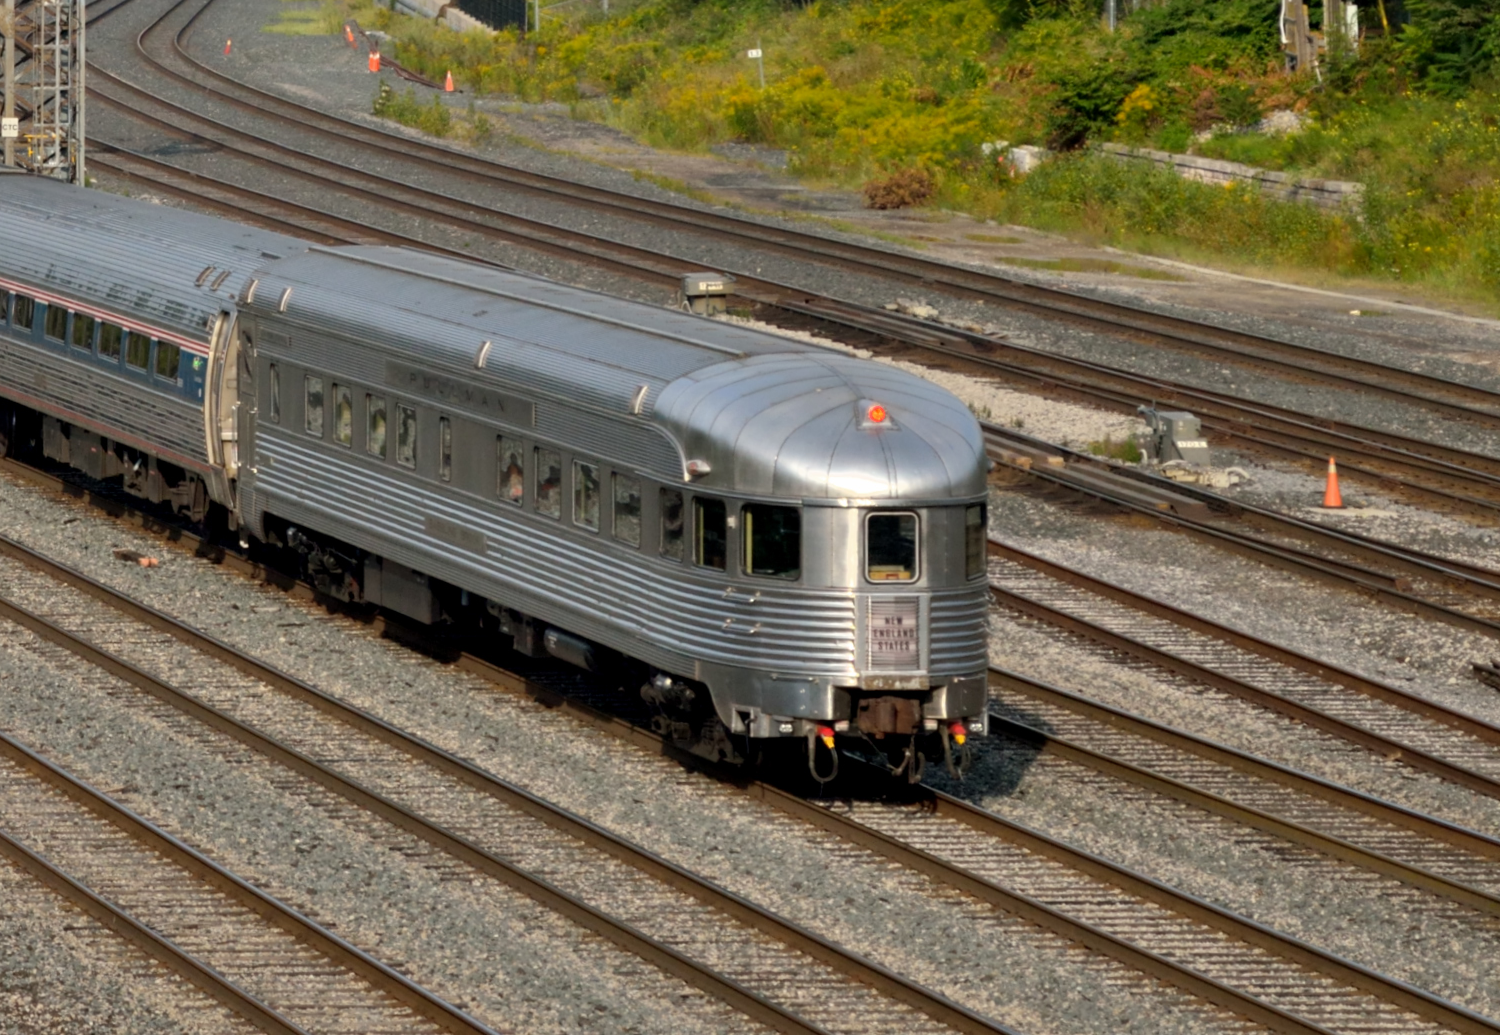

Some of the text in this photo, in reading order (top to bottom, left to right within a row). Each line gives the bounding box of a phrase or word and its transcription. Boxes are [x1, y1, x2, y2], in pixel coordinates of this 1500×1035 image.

[2, 123, 18, 131] CTC
[884, 616, 903, 625] NEW
[872, 628, 915, 638] ENGLAND
[877, 640, 910, 651] STATES
